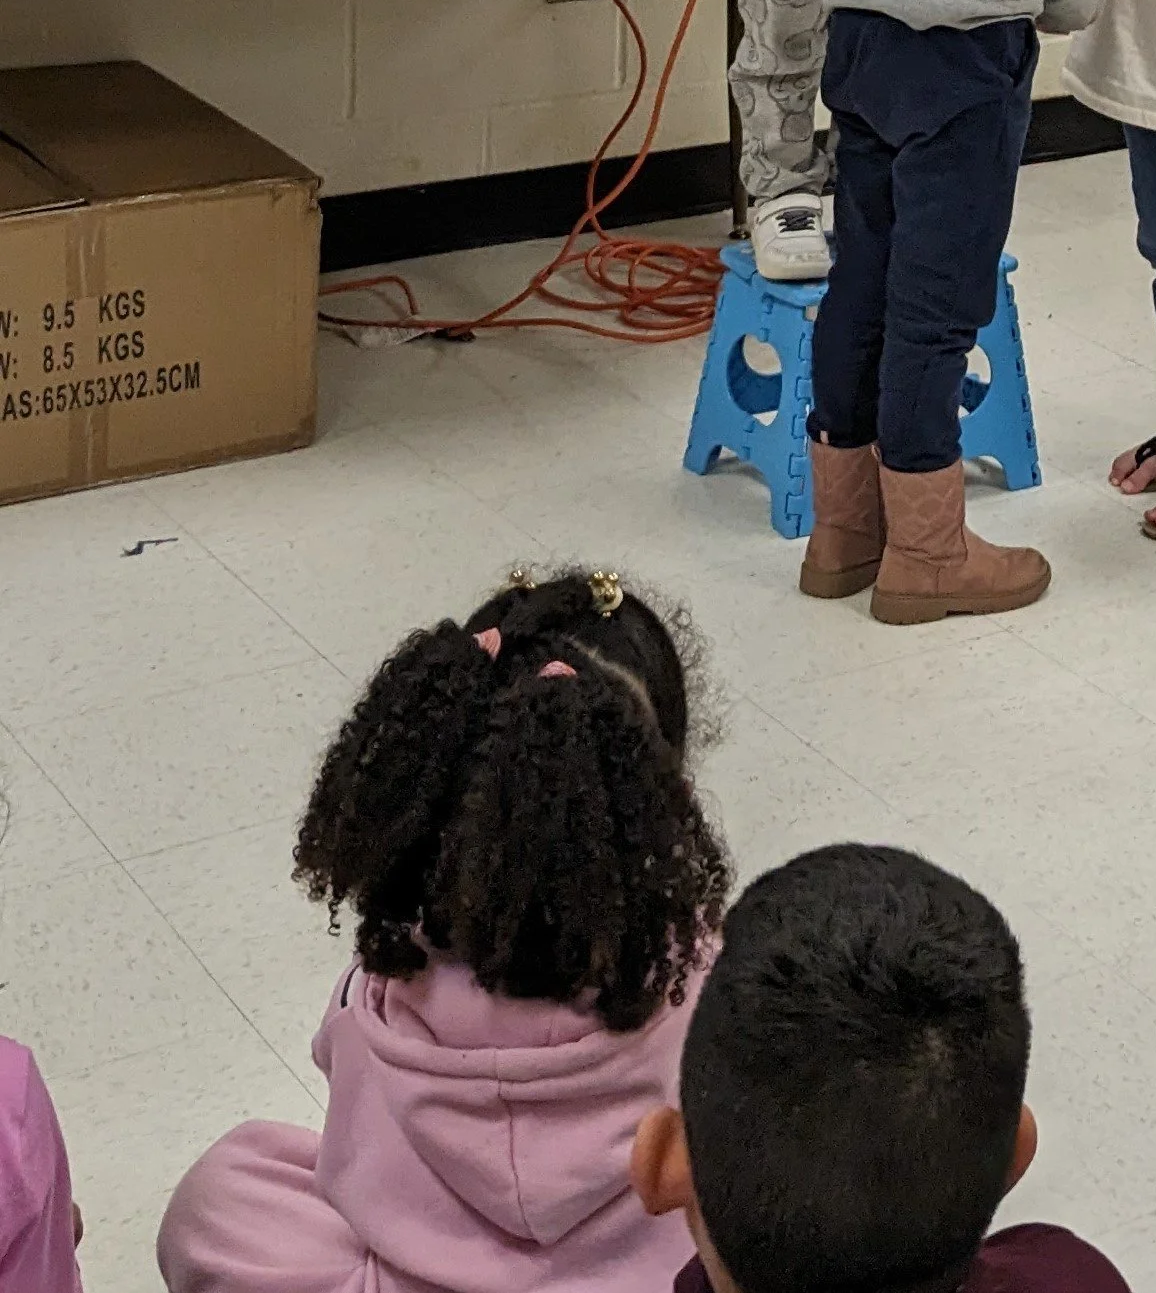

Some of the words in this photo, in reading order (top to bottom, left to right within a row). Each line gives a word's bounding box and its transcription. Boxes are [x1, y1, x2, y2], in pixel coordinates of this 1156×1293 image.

[43, 300, 75, 332] 9.5
[99, 289, 146, 324] KGS
[43, 341, 74, 373] 8.5
[98, 330, 145, 363] KGS
